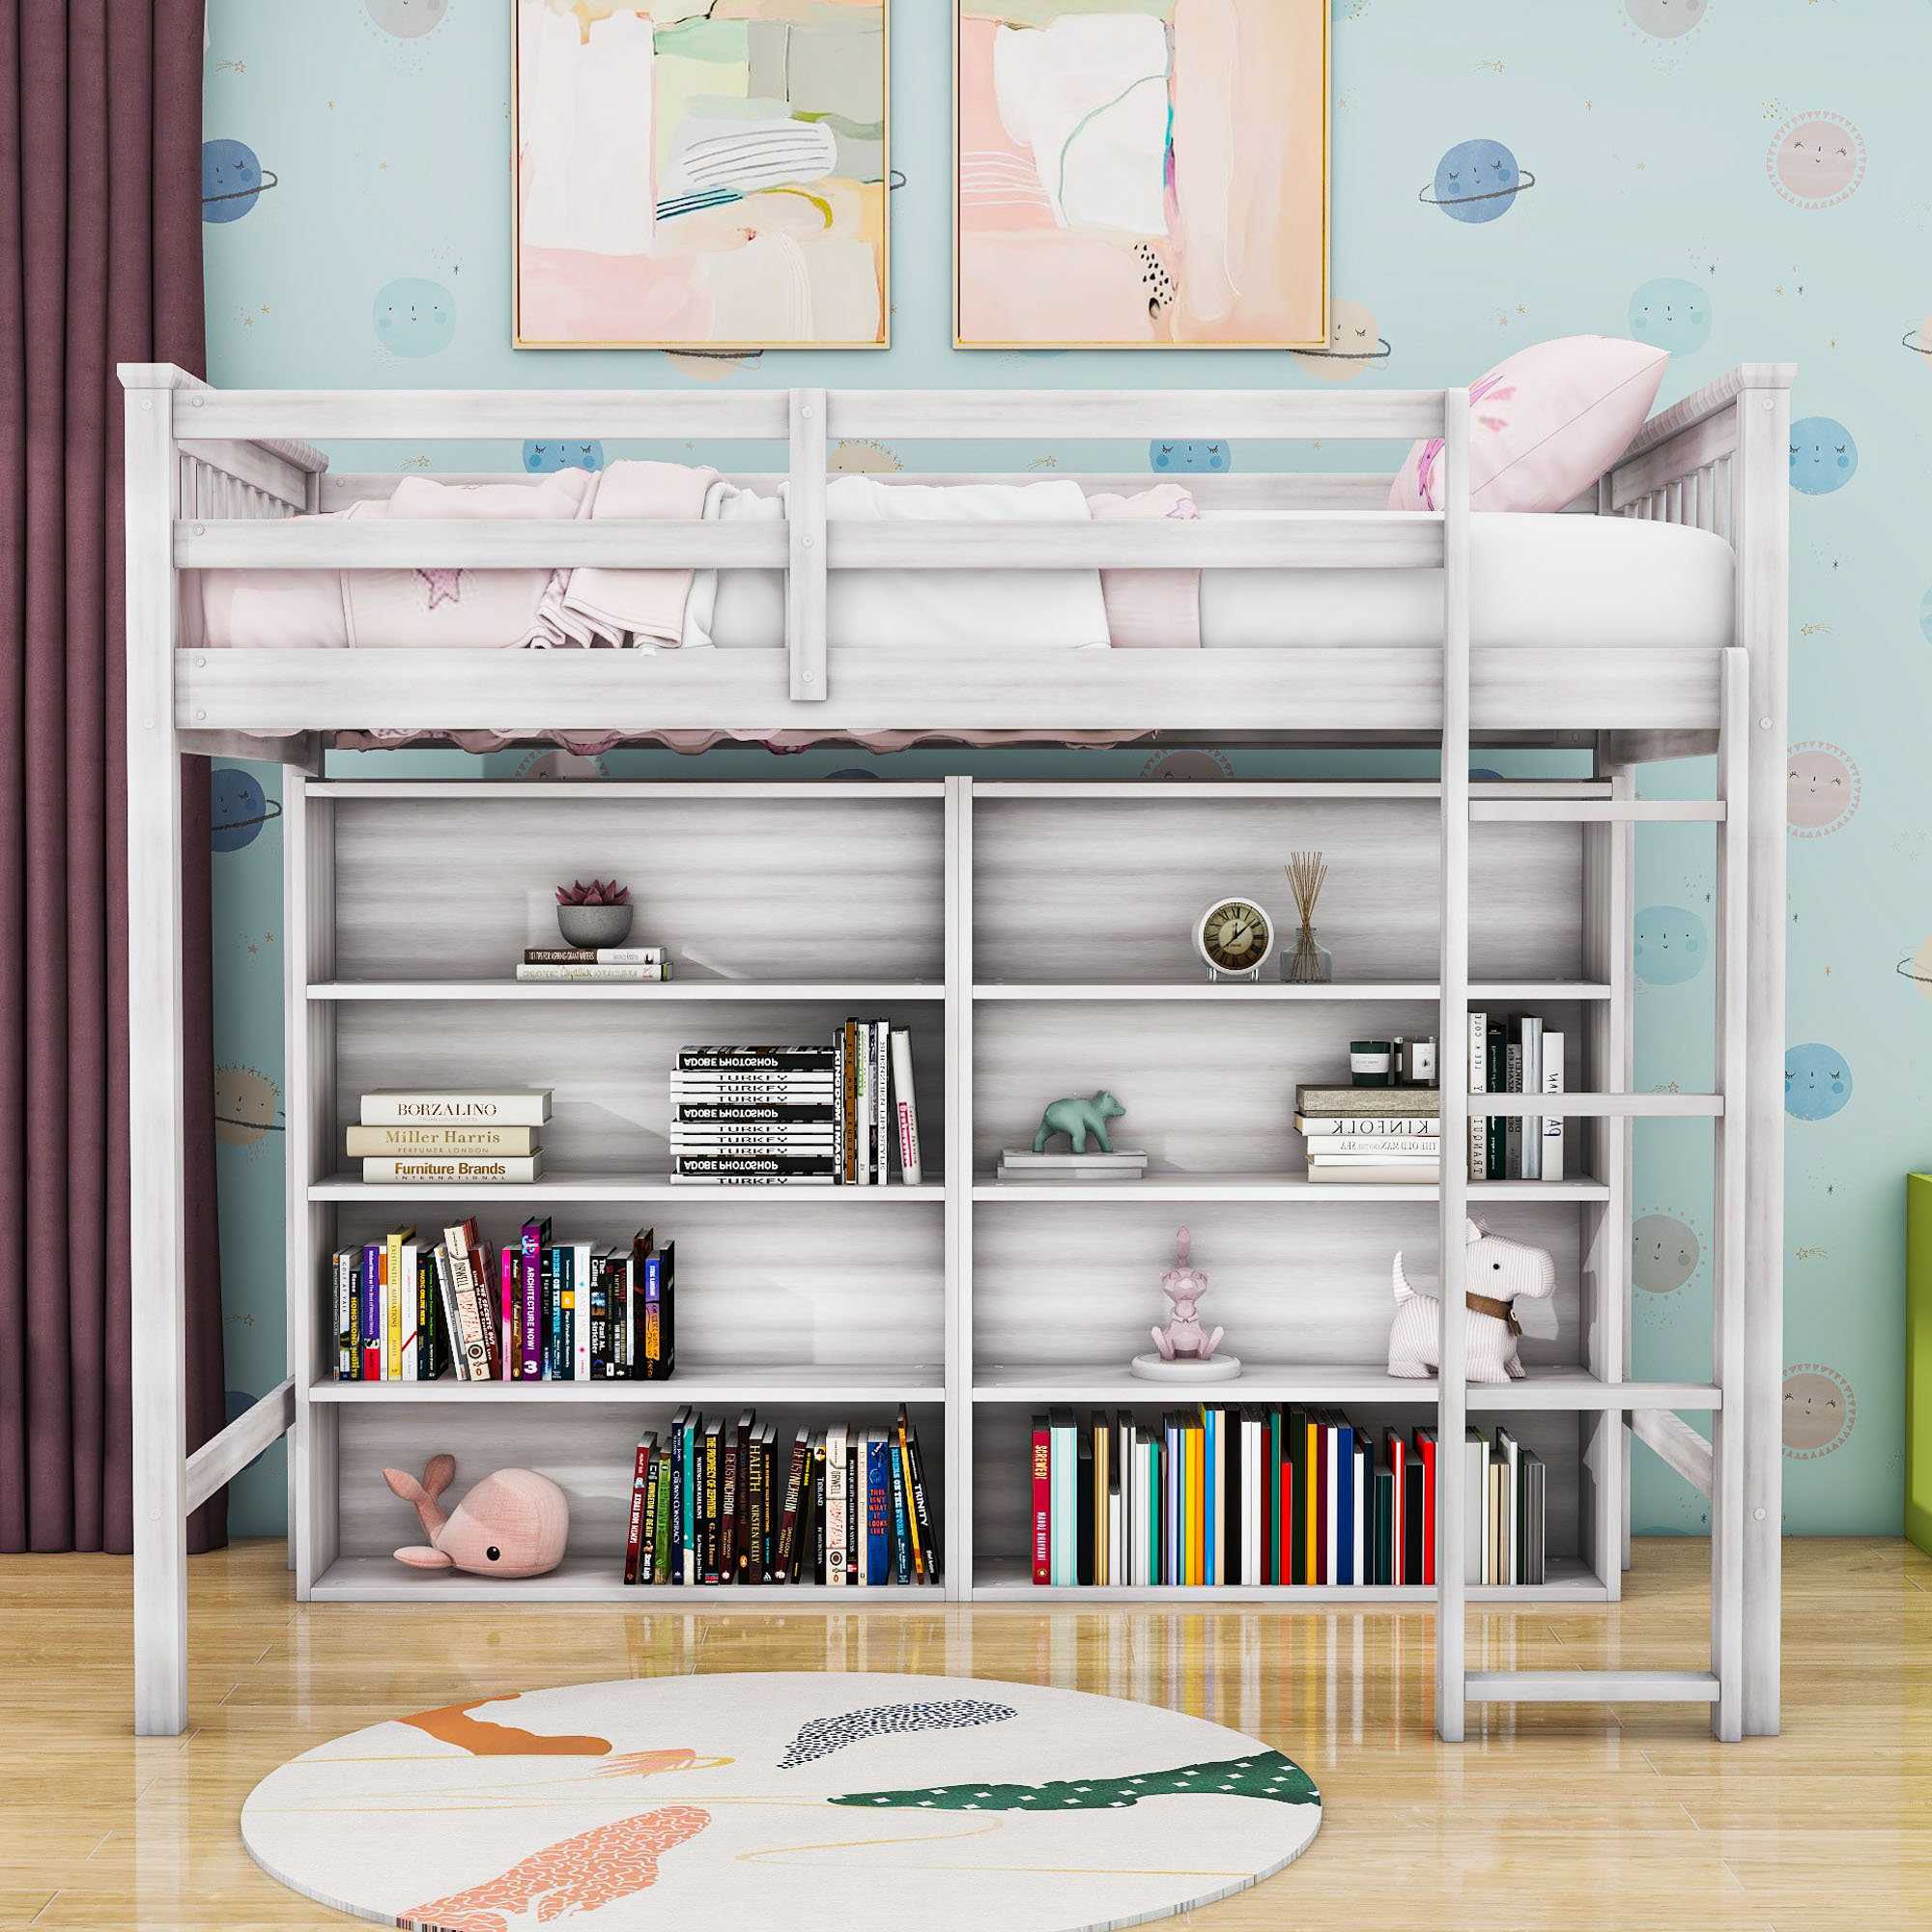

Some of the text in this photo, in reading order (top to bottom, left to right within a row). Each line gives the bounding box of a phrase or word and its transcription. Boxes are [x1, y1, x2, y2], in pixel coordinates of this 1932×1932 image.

[398, 1103, 497, 1115] BORZALINO
[386, 1130, 500, 1143] Miller Harris
[394, 1163, 506, 1175] Furniture Brands
[454, 1262, 469, 1288] ORWELL
[553, 1279, 560, 1290] ON
[342, 1284, 347, 1293] AT
[599, 1341, 606, 1350] M.
[707, 1436, 716, 1448] THE
[707, 1449, 716, 1479] PROPHECY
[750, 1445, 761, 1492] HALITH
[892, 1448, 902, 1478] RIDERS
[724, 1453, 736, 1515] GEOSYNCHRON
[784, 1448, 806, 1513] GEOSYNCHRON
[831, 1470, 840, 1494] ORWELL
[894, 1479, 901, 1491] ON
[647, 1482, 656, 1509] DUNGEON
[707, 1489, 716, 1518] ZEPHYRUS
[914, 1484, 928, 1526] TRINITY
[645, 1519, 654, 1537] DEATH
[709, 1522, 715, 1543] G. A.
[751, 1505, 759, 1563] KIRSTEN KELLY
[895, 1509, 904, 1536] STORM
